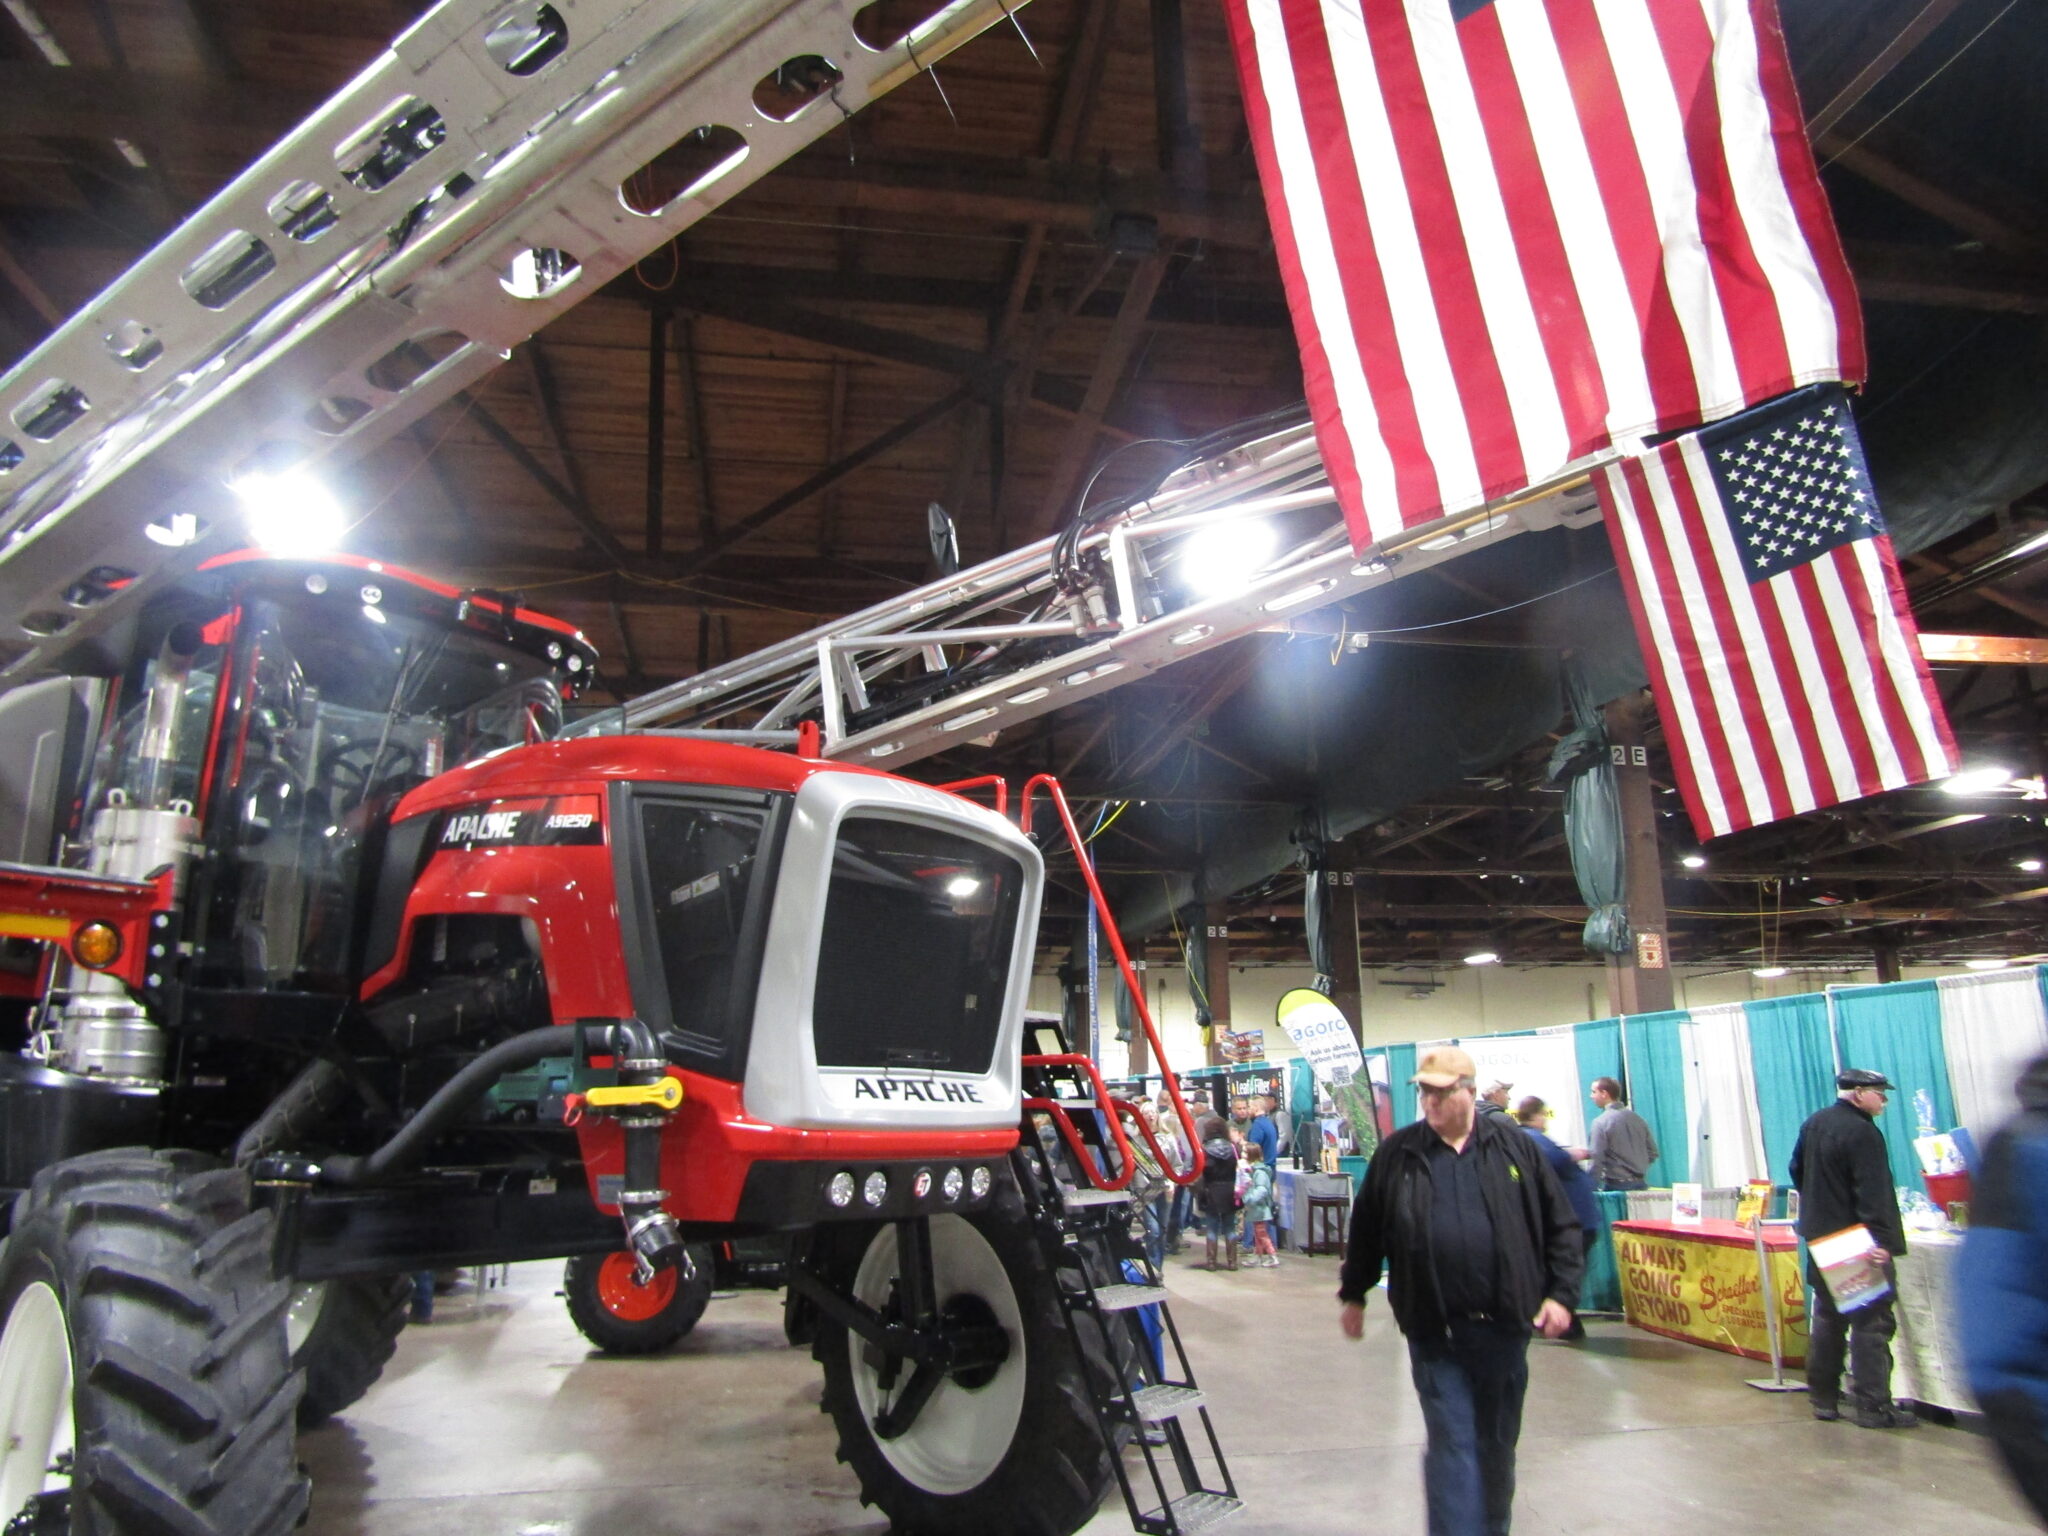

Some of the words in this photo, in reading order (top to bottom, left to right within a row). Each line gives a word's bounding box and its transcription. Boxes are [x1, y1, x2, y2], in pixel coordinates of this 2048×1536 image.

[442, 811, 522, 843] APACHE
[855, 1078, 983, 1103] APACHE
[1621, 1242, 1687, 1273] ALWAYS
[1628, 1267, 1681, 1299] GOING
